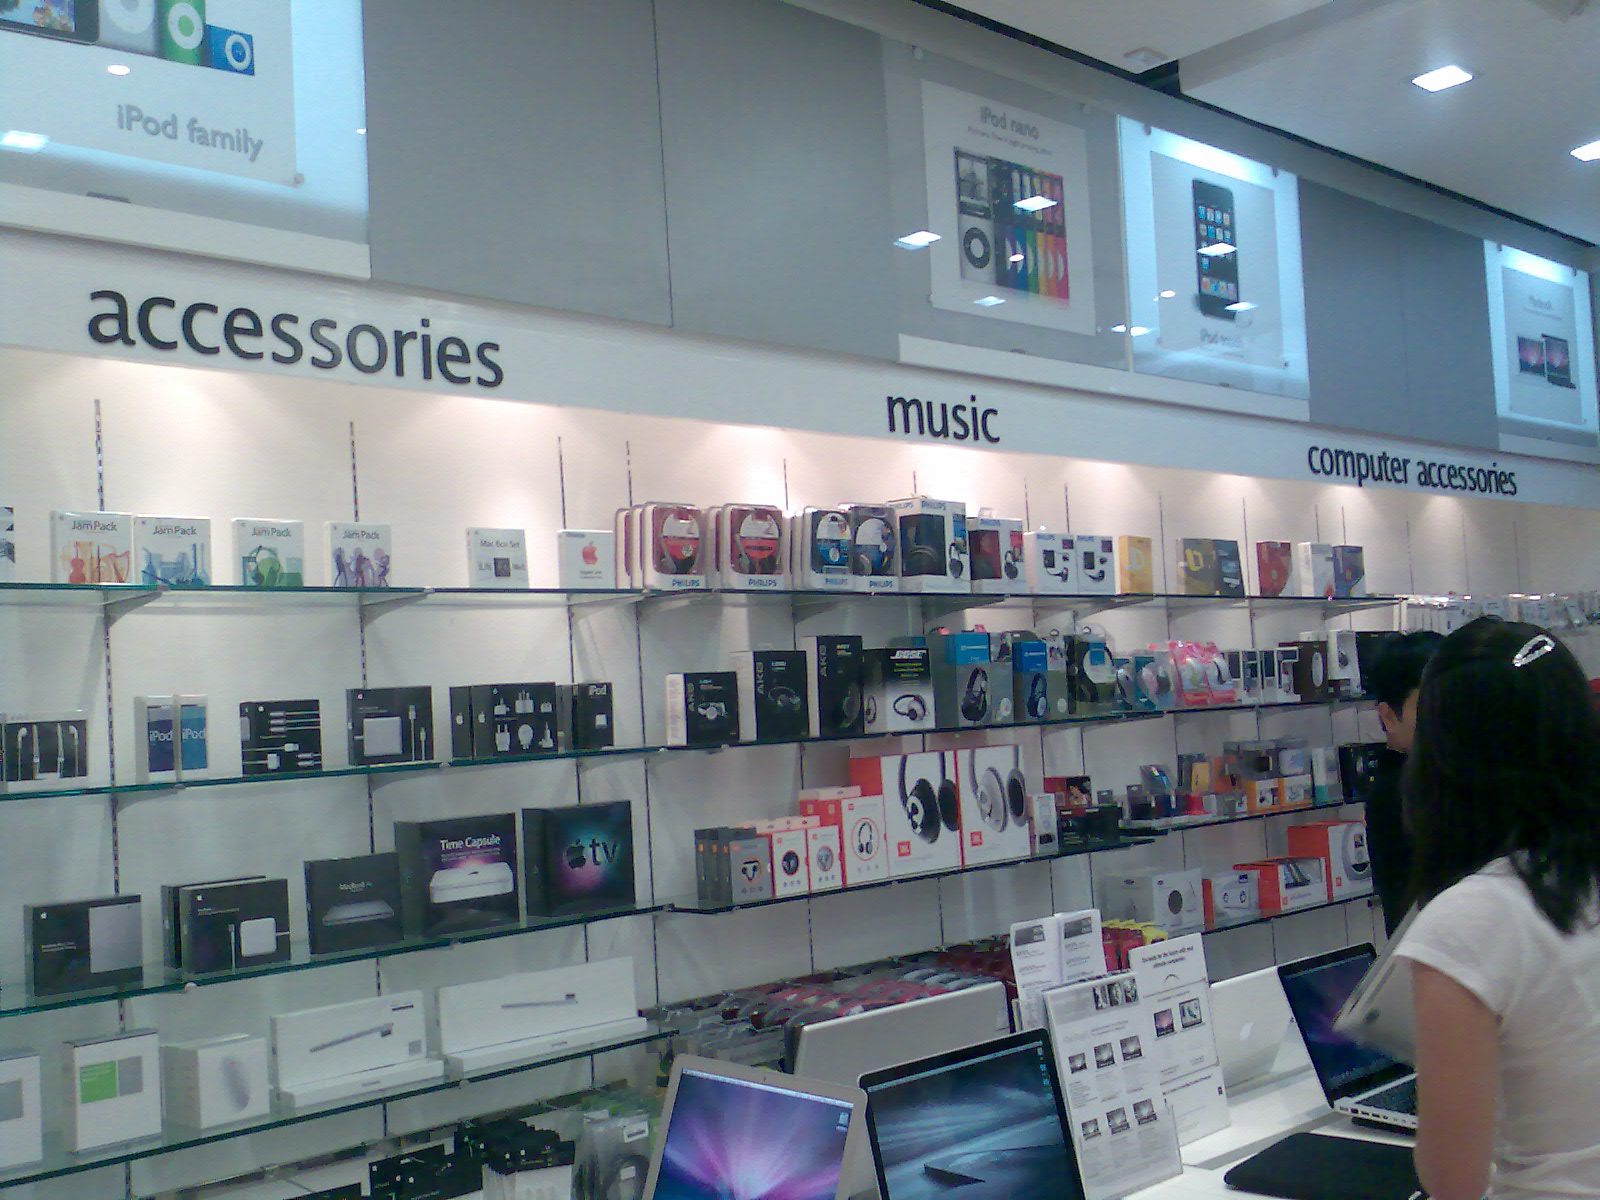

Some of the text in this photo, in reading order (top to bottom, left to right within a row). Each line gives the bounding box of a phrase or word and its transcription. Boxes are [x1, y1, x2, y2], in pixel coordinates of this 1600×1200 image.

[980, 106, 1007, 130] iPod
[117, 104, 263, 163] iPod family
[88, 288, 504, 389] accessories
[886, 394, 1001, 443] music
[1308, 445, 1517, 496] computer accessories
[71, 520, 117, 532] Jam Pack
[153, 525, 197, 536] Jam Pack
[251, 527, 292, 538] Jam Pack
[343, 530, 380, 540] Jam Pack
[671, 578, 700, 587] PHILIPS
[748, 578, 777, 587] PHILIPS
[869, 580, 893, 588] PHILIPS
[756, 661, 765, 695] AKG
[149, 730, 173, 742] iPod
[182, 728, 206, 740] iPod
[440, 834, 500, 850] Time Capsule
[590, 837, 618, 866] tv
